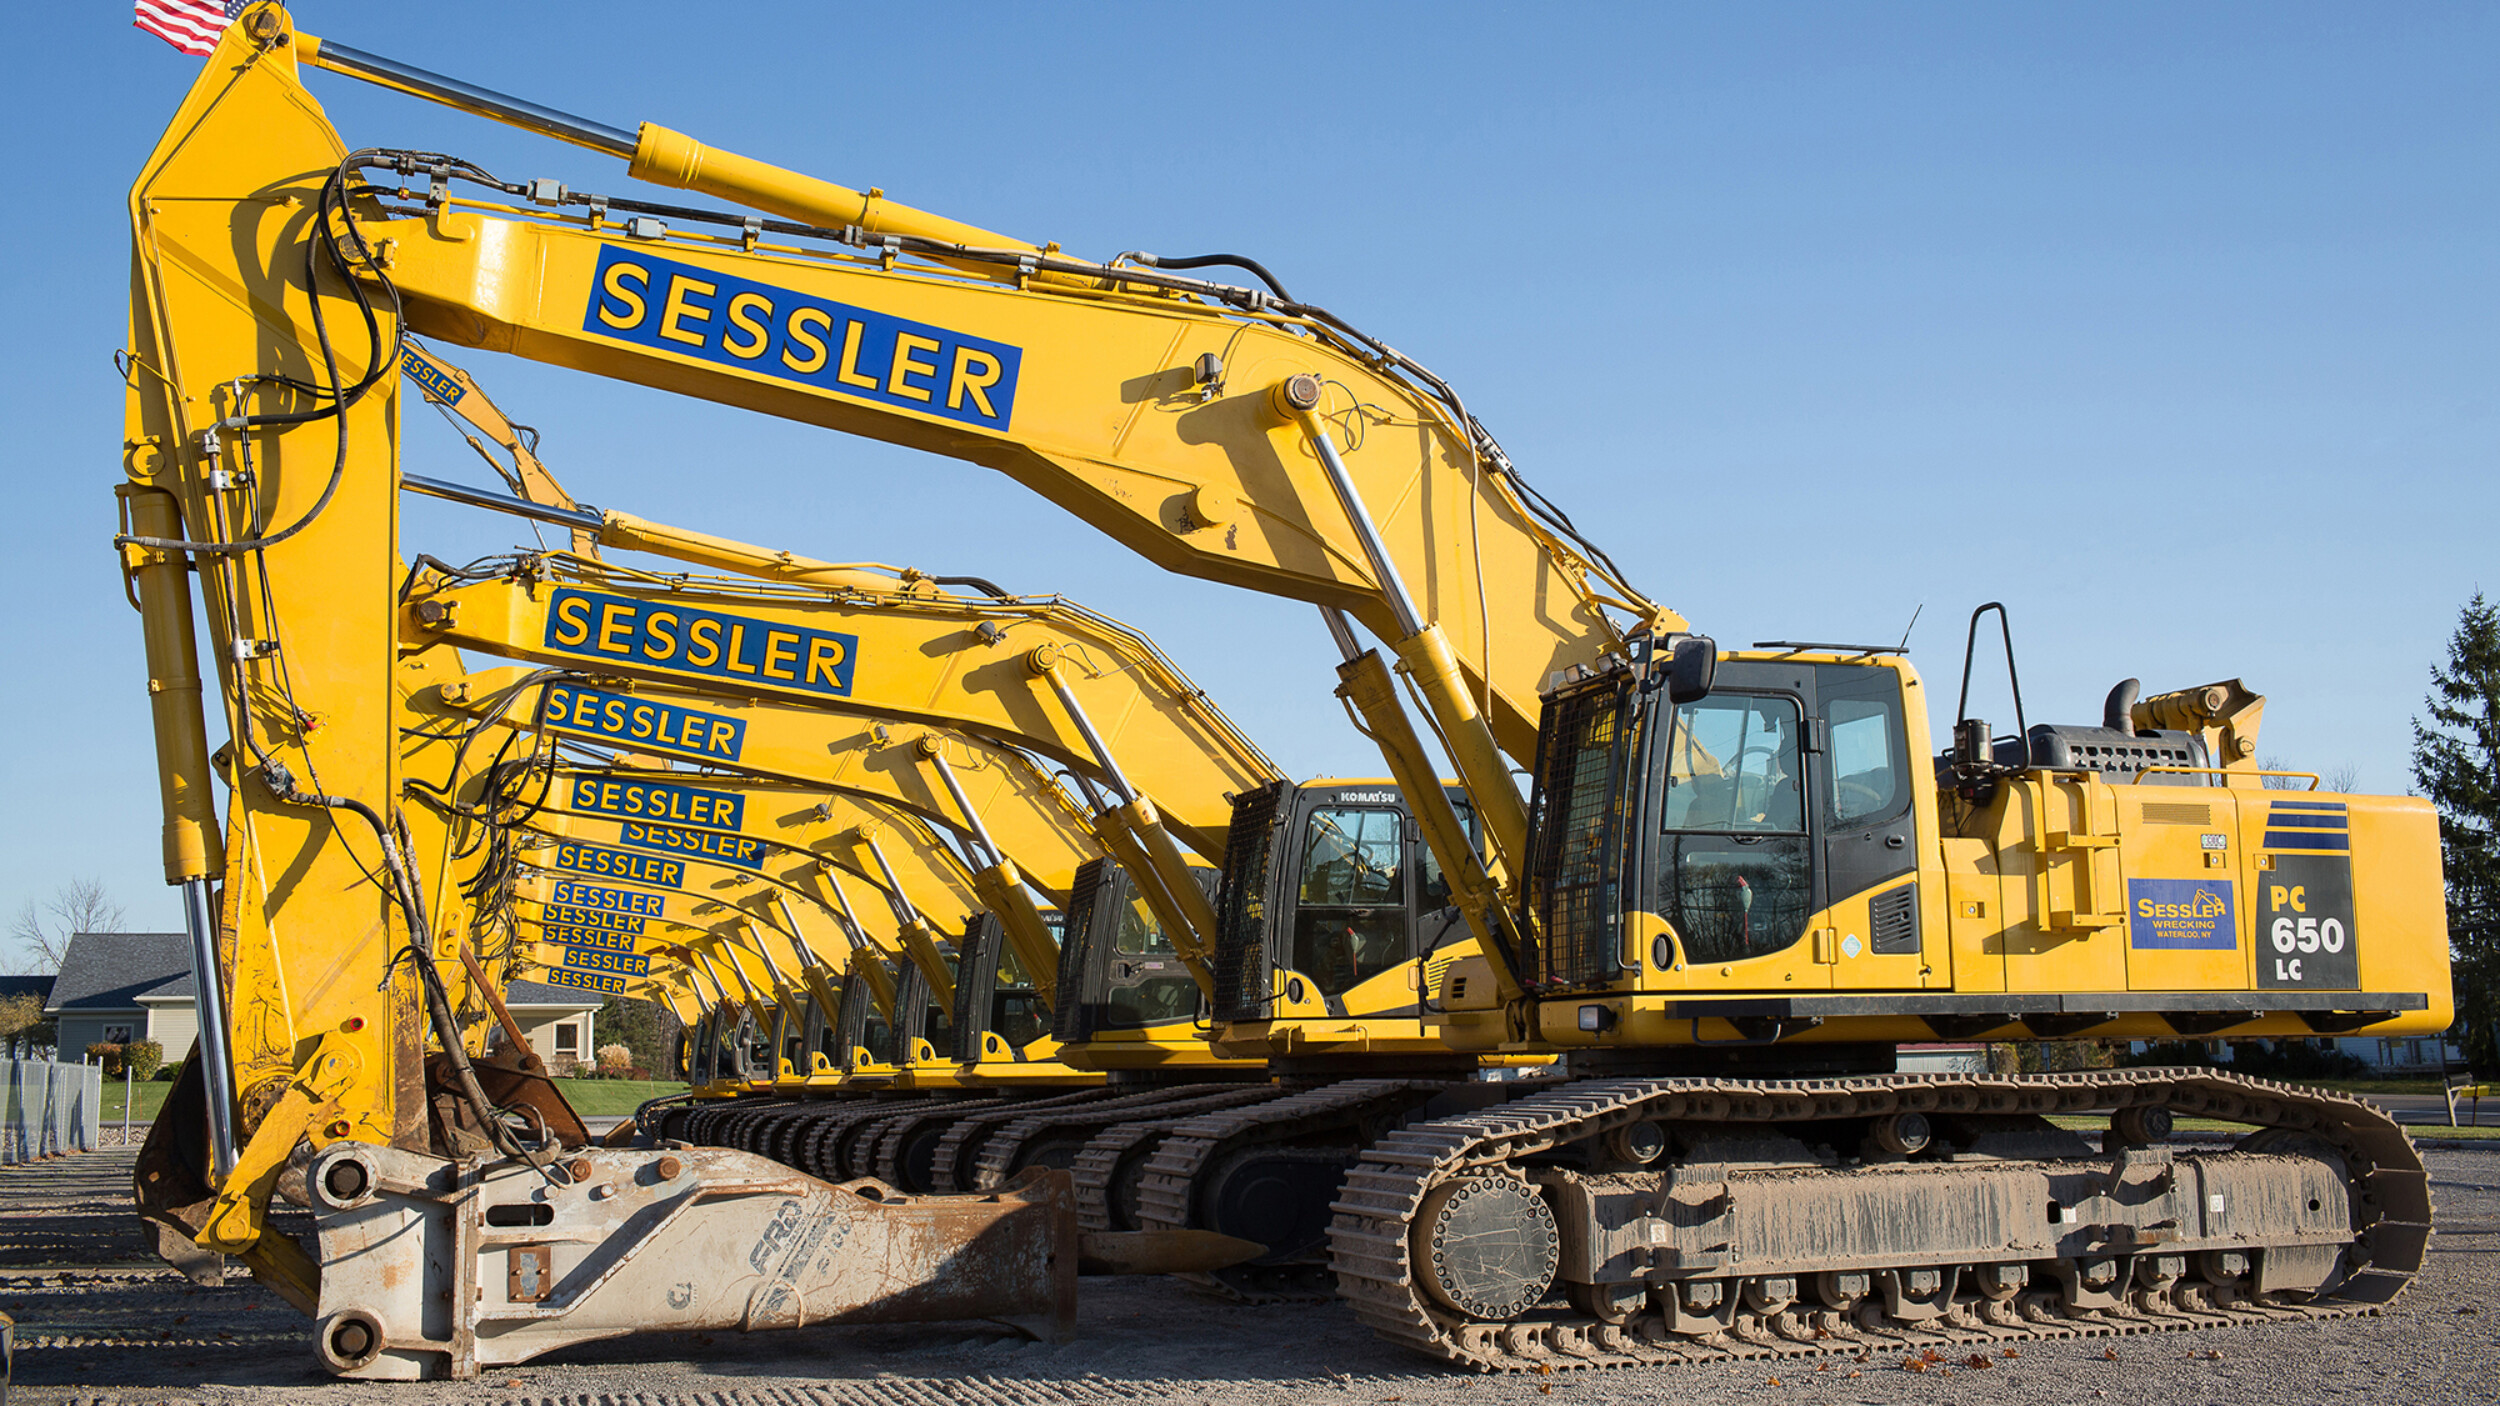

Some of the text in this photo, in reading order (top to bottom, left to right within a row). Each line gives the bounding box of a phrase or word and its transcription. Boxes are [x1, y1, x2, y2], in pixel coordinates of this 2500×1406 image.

[598, 261, 1004, 419] SESSLER
[554, 596, 847, 689] SESSLER
[546, 688, 736, 755] SESSLER
[577, 780, 736, 827] SESSLER
[1341, 791, 1395, 803] KOMATSU
[627, 823, 758, 861] SESSLER
[559, 845, 679, 884] SESSLER
[556, 884, 661, 915] SESSLER
[2138, 897, 2226, 918] SESSLER
[2270, 885, 2306, 912] PC
[545, 905, 642, 932] SESSLER
[2152, 920, 2216, 929] WRECKING
[545, 925, 632, 950] SESSLER
[2156, 930, 2200, 939] WATERLOO,
[2271, 917, 2345, 954] 650
[567, 950, 647, 974] SESSLER
[2275, 958, 2302, 980] LC
[550, 969, 624, 993] SESSLER
